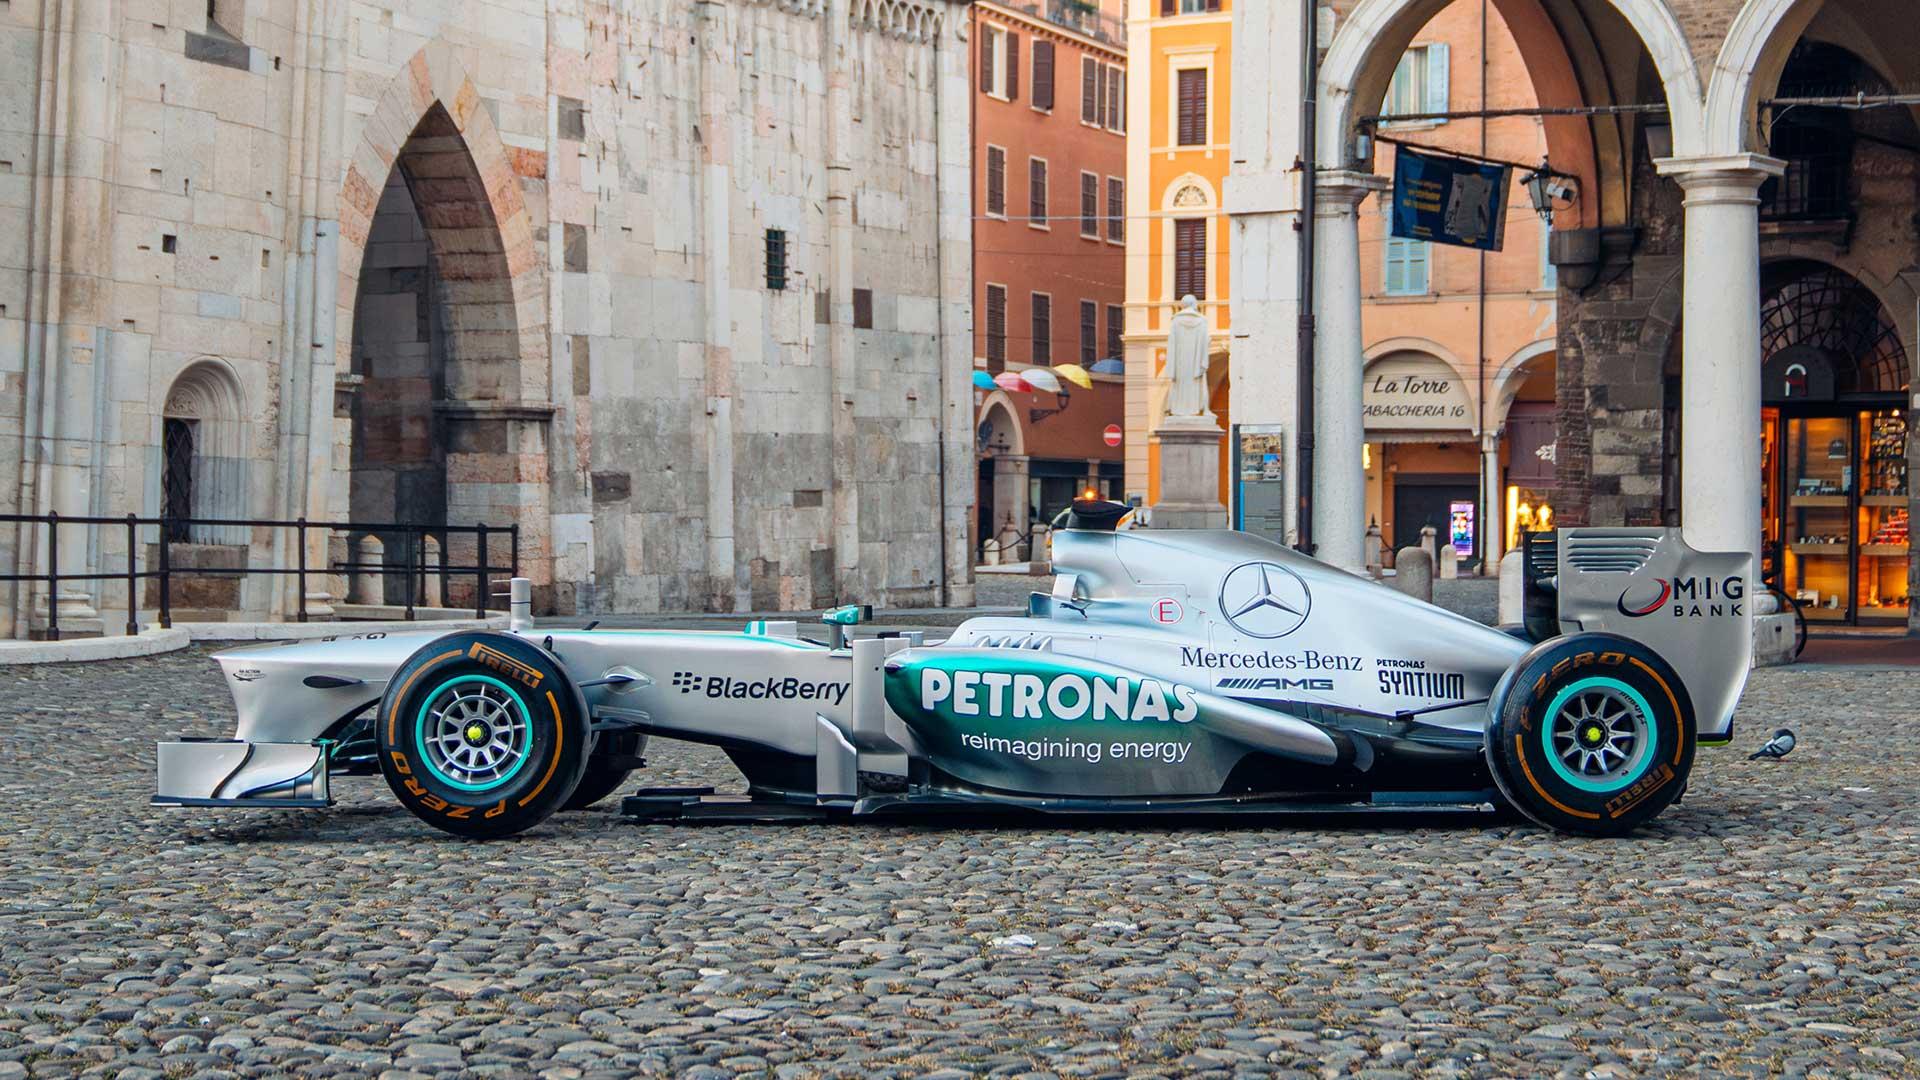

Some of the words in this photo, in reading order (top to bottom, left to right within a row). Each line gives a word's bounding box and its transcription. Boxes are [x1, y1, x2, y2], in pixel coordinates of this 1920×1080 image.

[1372, 375, 1398, 393] La
[1403, 375, 1450, 394] Torre
[1450, 405, 1465, 417] 16
[1674, 604, 1743, 617] BANK
[467, 641, 545, 689] PIRELLI
[1179, 646, 1363, 671] Mercedes-Benz
[1376, 659, 1425, 669] PETRONAS
[706, 677, 850, 705] BlackBerry
[920, 667, 1199, 723] PETRONAS
[1254, 678, 1334, 691] AMG
[1378, 670, 1465, 700] SYNTIUM
[961, 732, 1102, 763] reimagining
[1109, 738, 1192, 763] energy
[390, 751, 476, 819] ZERO
[1604, 763, 1675, 819] PIRELLI
[484, 800, 506, 818] P
